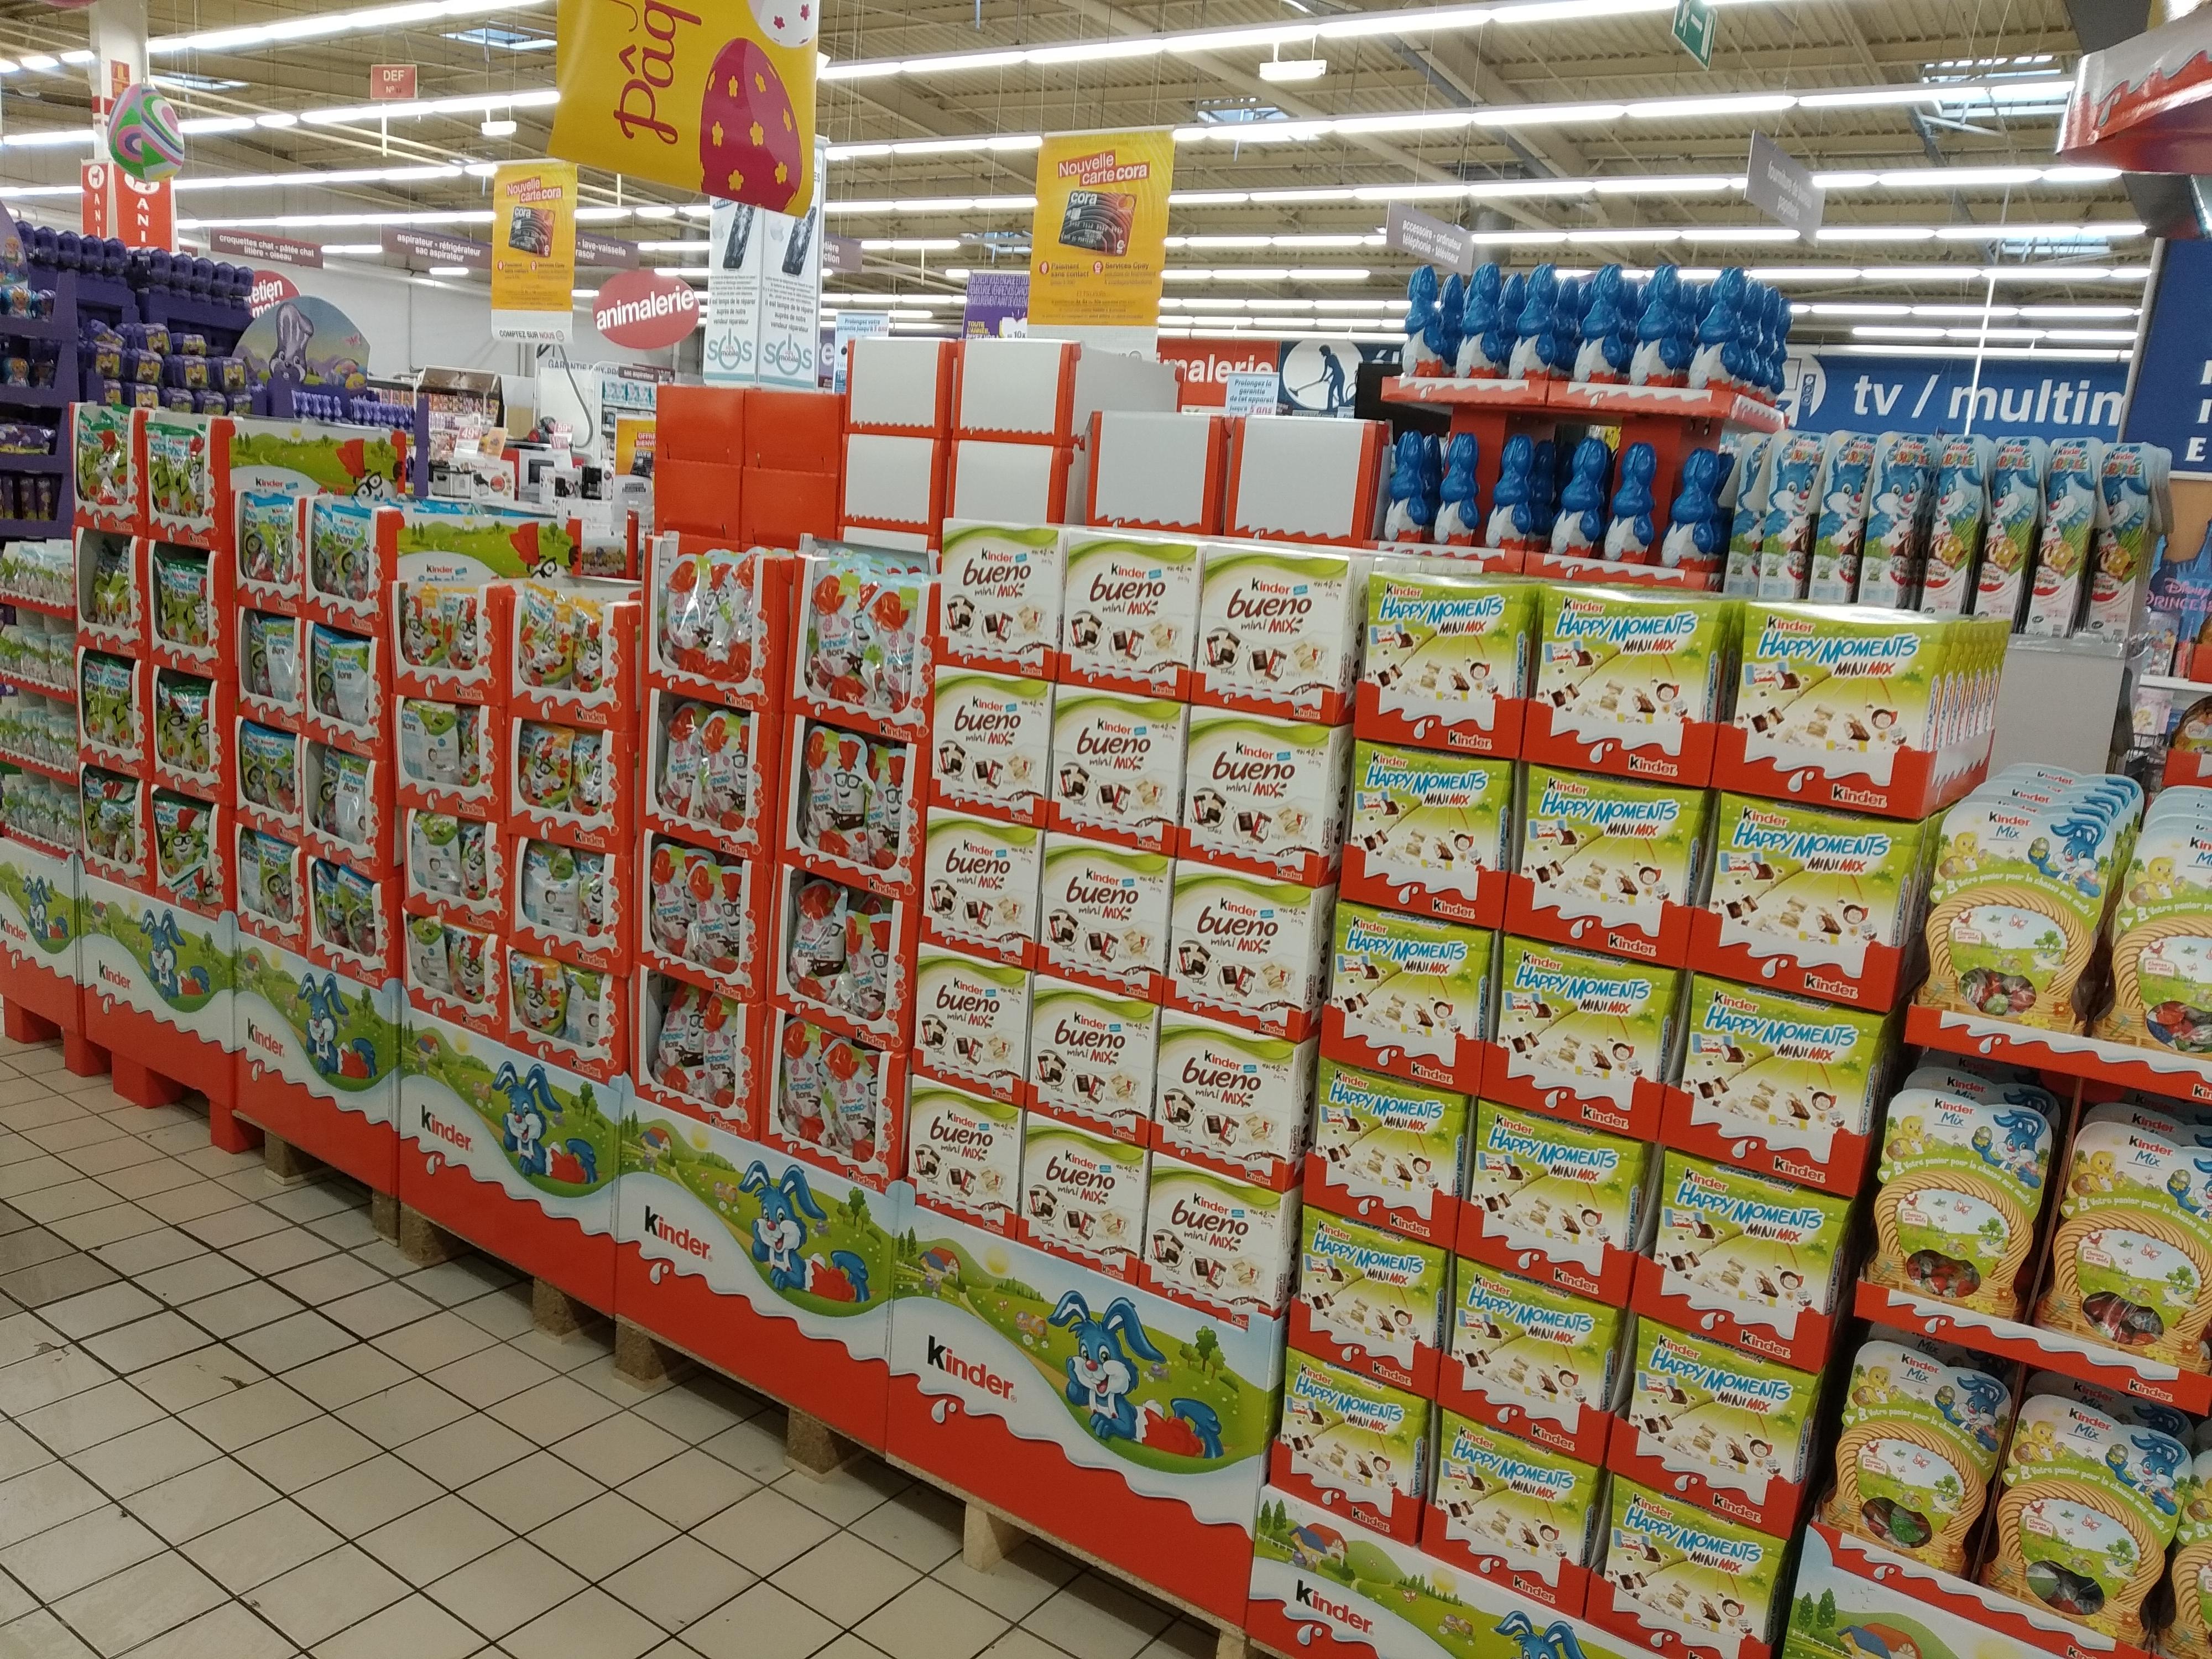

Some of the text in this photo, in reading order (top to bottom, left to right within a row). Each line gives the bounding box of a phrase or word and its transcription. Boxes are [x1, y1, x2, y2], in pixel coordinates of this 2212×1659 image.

[383, 70, 405, 82] DEF
[1059, 152, 1114, 178] Nouvelle
[1082, 164, 1147, 185] carte cora
[507, 178, 540, 196] Nouvelle
[520, 187, 562, 202] carte cora
[1071, 192, 1098, 205] cora
[514, 207, 531, 219] cora
[1402, 220, 1462, 251] accessoire ordinateur
[219, 234, 257, 247] croquettes
[258, 240, 274, 251] chat
[300, 247, 314, 258] chat
[244, 246, 292, 262] litière oiseau
[397, 233, 627, 257] aspirateur réfrigérateur lave-vaisselle
[822, 242, 839, 254] tière
[1402, 232, 1460, 264] téléphonie téléviseur
[415, 247, 428, 256] sac
[429, 248, 465, 263] aspirateur
[822, 254, 841, 265] ction
[596, 285, 695, 331] animalerie
[499, 330, 555, 340] COMPTEZ SUR NOUS
[1234, 379, 1265, 388] Prolongez
[1248, 395, 1274, 404] appareil
[1853, 375, 1902, 417] tv
[1227, 588, 1313, 619] bueno
[1380, 594, 1505, 625] HAPPY MOMENTS
[1241, 618, 1295, 635] mini MIX
[1439, 620, 1486, 634] MINI MIX
[1757, 631, 1919, 665] HAPPY MOMENTS
[1833, 661, 1896, 676] MINI MIX
[1076, 728, 1151, 755] bueno
[1089, 755, 1138, 771] mini MIX
[1996, 825, 2020, 839] Mix
[946, 848, 1011, 875] bueno
[1957, 874, 1978, 886] Votre
[1979, 873, 2004, 884] panier
[2005, 873, 2024, 884] pour
[2025, 874, 2033, 883] la
[2034, 877, 2060, 893] chasse
[1515, 966, 1651, 1000] HAPPY MOMENTS
[1579, 999, 1632, 1015] MINI MIX
[1941, 1112, 1964, 1126] Mix
[1171, 1199, 1249, 1235] bueno
[1183, 1228, 1233, 1251] mini MIX
[2075, 1422, 2099, 1440] Mix
[1625, 1507, 1762, 1563] HAPPY MOMENTS
[1689, 1549, 1742, 1574] MINI MIX
